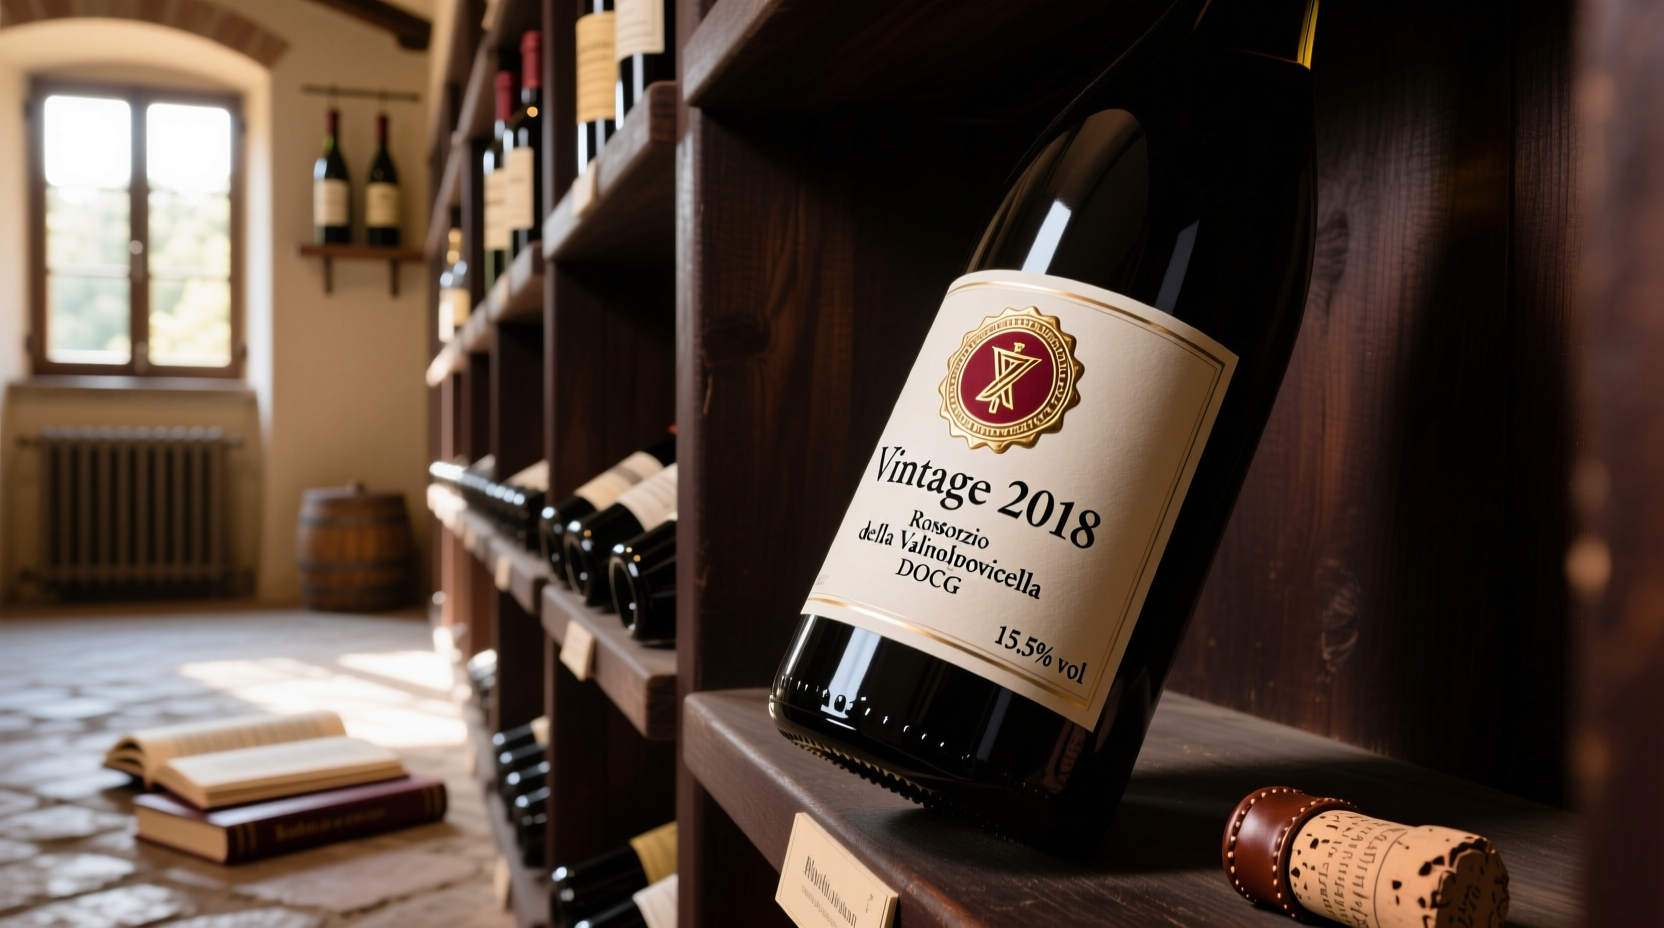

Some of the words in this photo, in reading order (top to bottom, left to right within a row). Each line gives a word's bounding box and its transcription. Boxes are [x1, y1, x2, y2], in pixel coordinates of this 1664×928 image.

[876, 446, 991, 511] Vintage
[998, 480, 1101, 549] 2018
[858, 520, 894, 546] della
[895, 558, 962, 595] DOCG
[994, 625, 1053, 668] 15.5%
[1057, 657, 1088, 686] vol
